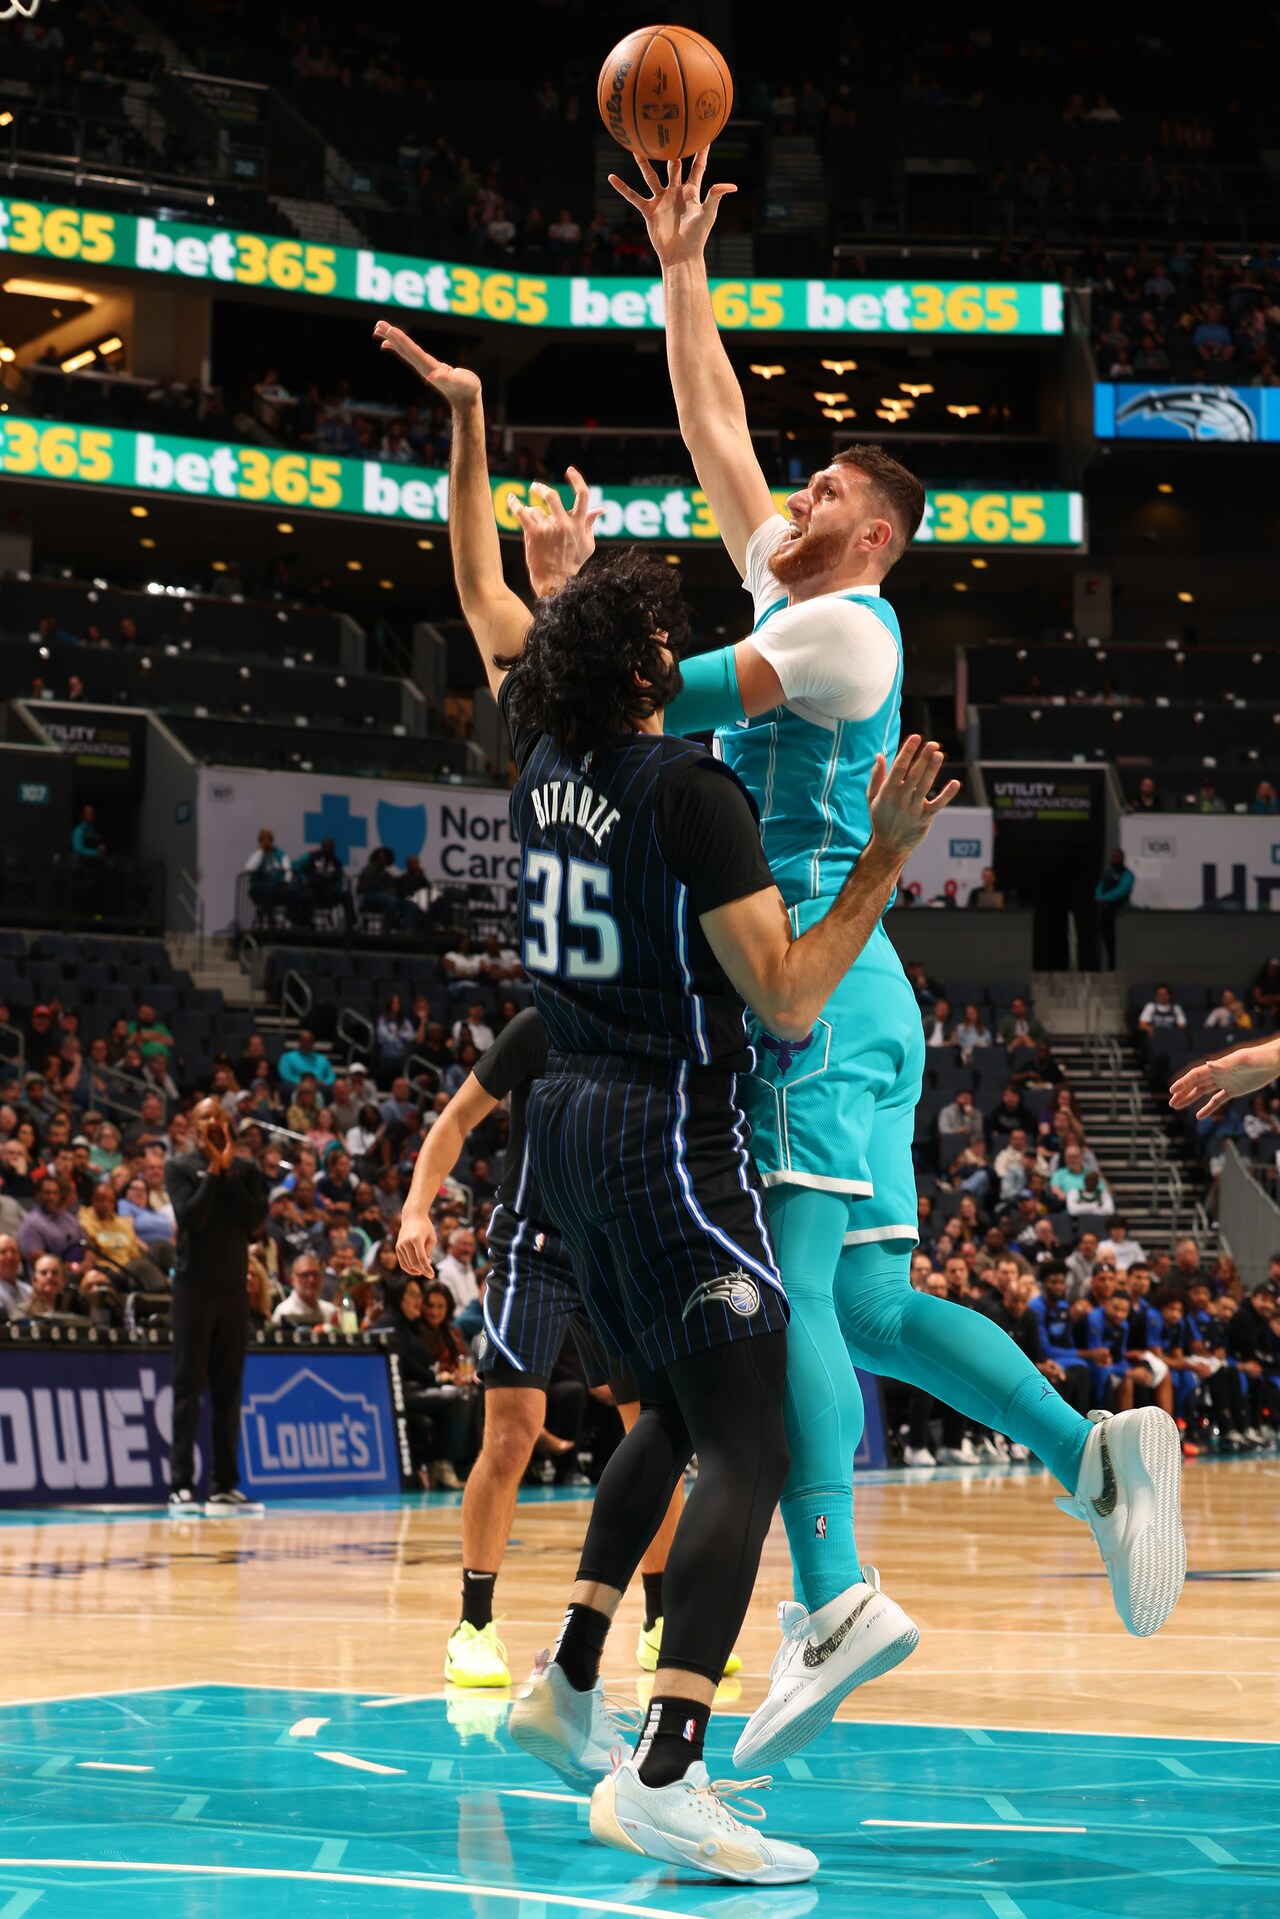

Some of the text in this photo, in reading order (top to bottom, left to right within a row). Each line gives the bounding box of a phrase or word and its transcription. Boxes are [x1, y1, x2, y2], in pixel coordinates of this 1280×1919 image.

[606, 60, 633, 145] Wilson
[136, 217, 336, 294] bet365
[356, 249, 548, 325] bet365
[570, 278, 784, 329] bet65
[807, 281, 1018, 331] bet365
[0, 420, 113, 481] 365
[135, 432, 343, 508] bet365
[43, 724, 96, 741] TILITY
[531, 781, 621, 847] BITADZE
[994, 783, 1055, 796] UTILITY
[1013, 797, 1090, 809] INNOVATION
[953, 842, 977, 855] 107
[525, 848, 622, 981] 35
[256, 1412, 370, 1469] LOWE'S
